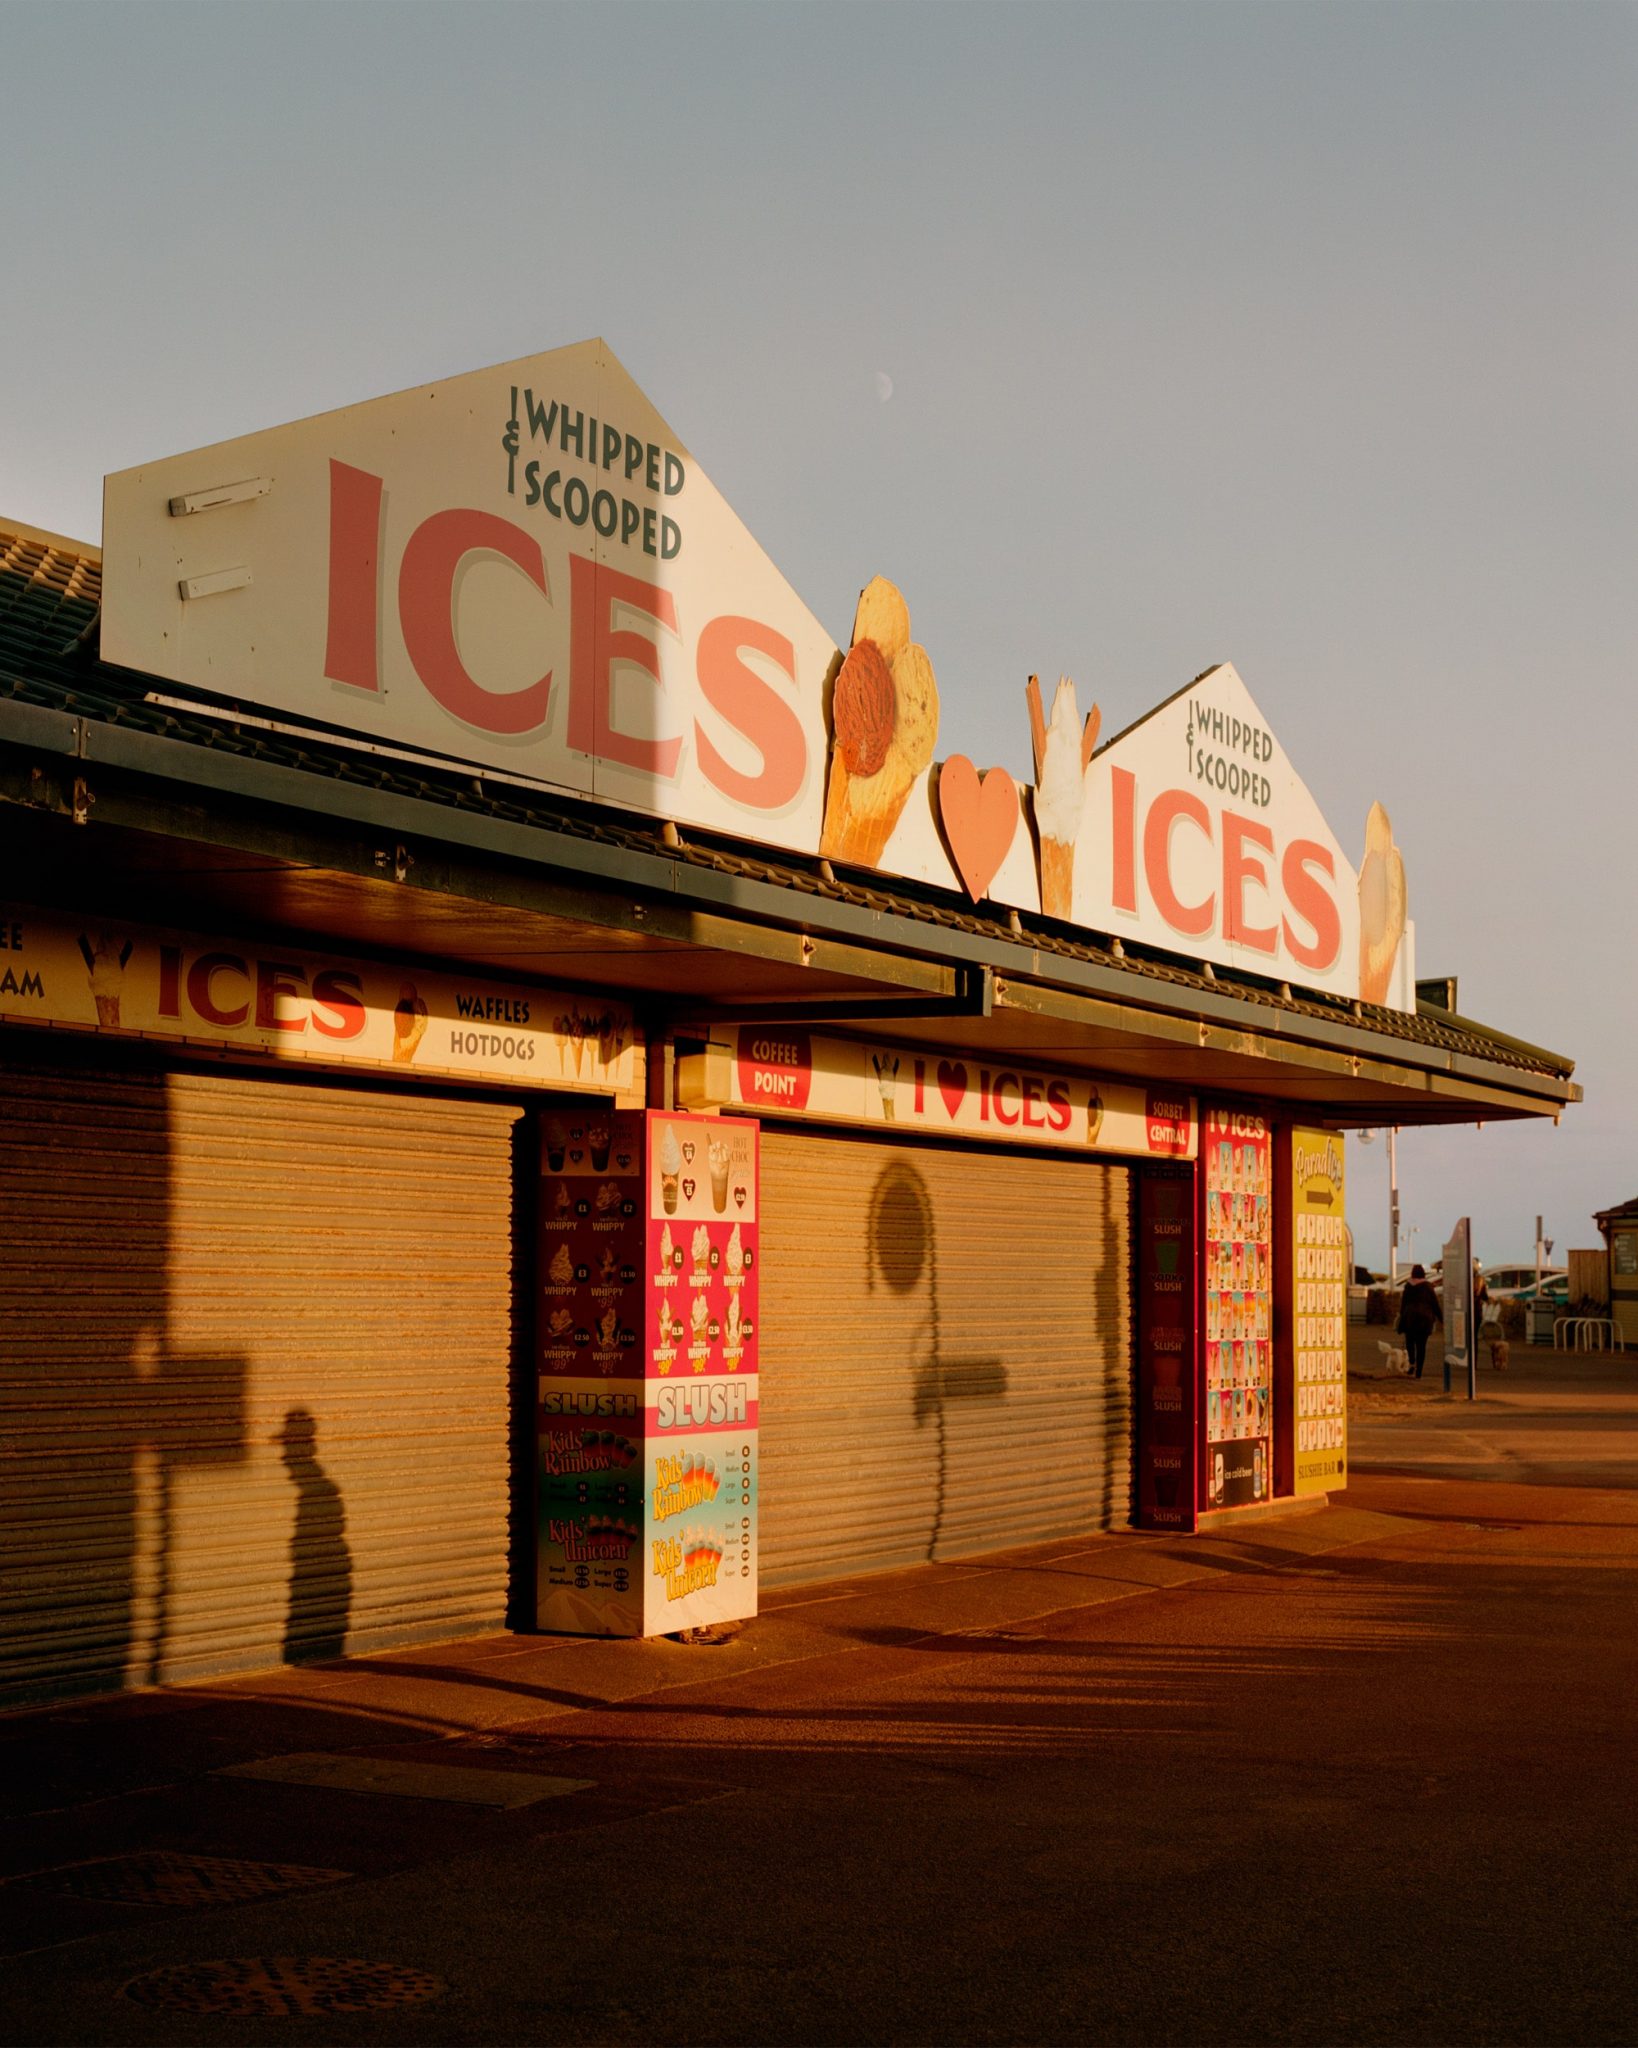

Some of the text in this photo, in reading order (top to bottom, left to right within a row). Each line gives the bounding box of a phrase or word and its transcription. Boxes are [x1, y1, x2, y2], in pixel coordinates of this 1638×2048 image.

[523, 388, 685, 498] WHIPPED
[525, 460, 682, 560] SCOOPED
[323, 458, 808, 810] ICES
[1195, 700, 1273, 762] WHIPPED
[1196, 748, 1271, 808] SCOOPED
[1111, 764, 1341, 971] ICES
[158, 945, 367, 1039] ICES
[455, 994, 530, 1024] WAFFLES
[450, 1031, 535, 1061] HOTDOGS
[752, 1039, 798, 1065] COFFEE
[754, 1070, 797, 1097] POINT
[913, 1057, 1073, 1131] I ICES
[1153, 1101, 1184, 1121] SORBET
[1150, 1125, 1187, 1146] CENTRAL
[1210, 1110, 1265, 1140] I ICES
[733, 1136, 747, 1149] HOT
[731, 1151, 749, 1163] CHOC
[578, 1204, 633, 1213] £1 £2
[545, 1221, 625, 1231] WHIPPY WHIPPY
[1154, 1224, 1182, 1234] SLUSH
[675, 1252, 682, 1263] £1
[711, 1252, 718, 1263] £2
[578, 1269, 586, 1277] £3
[654, 1275, 746, 1287] WHIPPY WHIPPY WHIPPY
[544, 1286, 624, 1296] WHIPPY WHIPPY
[1154, 1281, 1182, 1292] SLUSH
[544, 1349, 624, 1360] WHIPPY WHIPPY
[653, 1347, 744, 1361] WHIPPY WHIPPY WHIPPY
[1154, 1340, 1182, 1351] SLUSH
[544, 1391, 637, 1417] SLUSH
[657, 1382, 747, 1429] SLUSH
[1154, 1400, 1182, 1411] SLUSH
[543, 1450, 612, 1476] Rainbow
[655, 1449, 685, 1490] Kids'
[1153, 1457, 1181, 1468] SLUSH
[1298, 1460, 1336, 1480] SLUSHIE BAR
[652, 1481, 704, 1523] Rainbow
[1153, 1511, 1181, 1522] SLUSH
[549, 1515, 585, 1545] Kids'
[565, 1539, 628, 1562] Unicorn
[652, 1528, 684, 1578] Kids'
[664, 1560, 717, 1602] Unicorn
